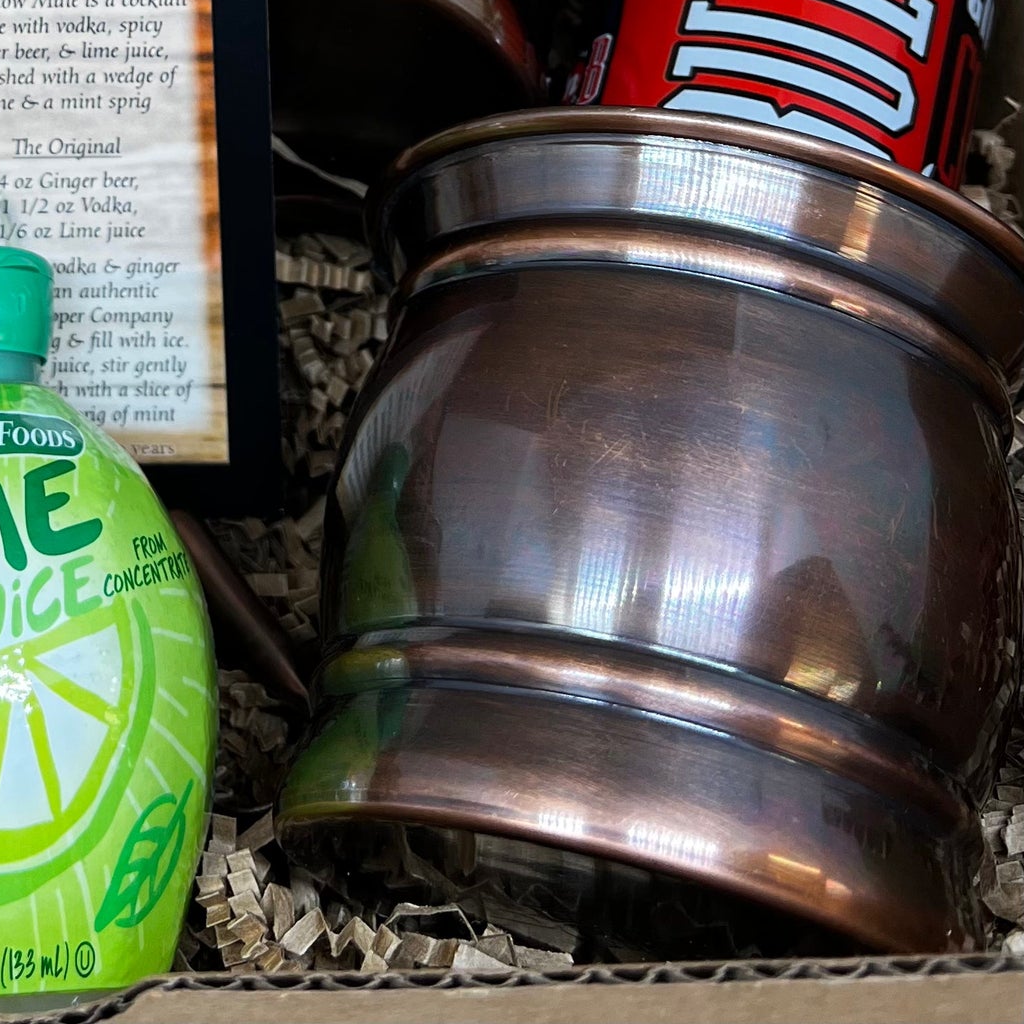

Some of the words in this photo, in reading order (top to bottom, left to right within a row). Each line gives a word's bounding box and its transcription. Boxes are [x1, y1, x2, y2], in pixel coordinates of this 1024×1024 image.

[13, 17, 49, 34] with
[56, 16, 112, 35] vodka,
[118, 17, 163, 38] spicy
[15, 43, 51, 62] beer,
[58, 43, 76, 59] &
[81, 42, 119, 59] lime
[123, 42, 169, 63] juice,
[42, 67, 79, 85] with
[86, 70, 96, 84] a
[104, 66, 153, 89] wedge
[159, 65, 179, 88] of
[21, 94, 39, 110] &
[43, 98, 53, 110] a
[61, 93, 102, 110] mint
[108, 92, 151, 114] sprig
[12, 137, 43, 156] The
[48, 137, 122, 160] Original
[14, 176, 33, 189] oz
[39, 172, 98, 194] Ginger
[102, 171, 139, 191] beer,
[1, 199, 10, 215] 1
[20, 198, 49, 215] 1/2
[56, 200, 75, 214] oz
[81, 196, 138, 216] Vodka,
[0, 223, 27, 240] 1/6
[34, 226, 53, 239] oz
[59, 222, 102, 239] Lime
[105, 223, 146, 242] juice
[104, 259, 121, 274] &
[126, 257, 180, 279] ginger
[79, 282, 159, 299] authentic
[90, 307, 174, 329] Company
[68, 333, 84, 349] &
[88, 330, 113, 353] fill
[120, 330, 156, 348] with
[163, 331, 189, 348] ice.
[50, 356, 95, 378] juice,
[101, 357, 129, 373] stir
[134, 355, 187, 377] gently
[76, 380, 112, 397] with
[118, 385, 128, 397] a
[134, 380, 170, 397] slice
[176, 379, 194, 401] of
[112, 405, 131, 426] of
[134, 406, 176, 422] mint
[130, 442, 175, 456] years
[132, 532, 168, 561] FROM
[1, 947, 35, 989] (133
